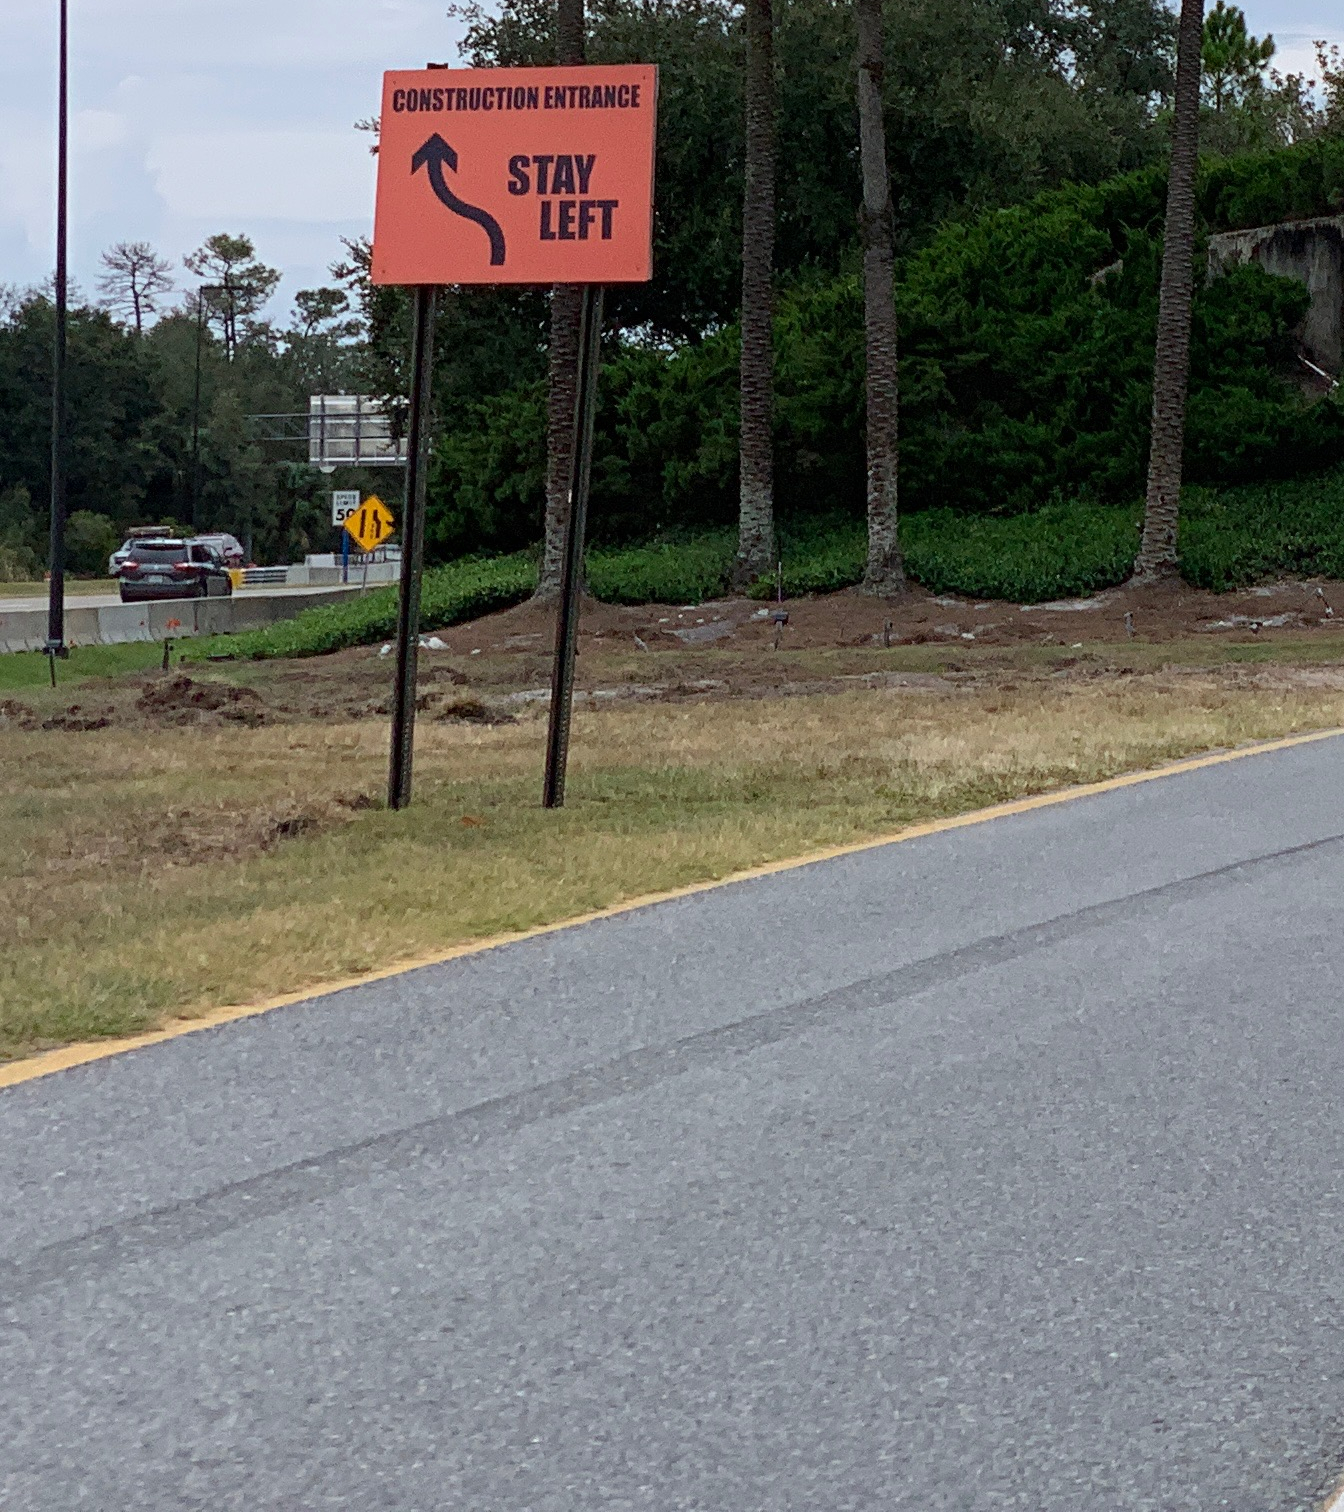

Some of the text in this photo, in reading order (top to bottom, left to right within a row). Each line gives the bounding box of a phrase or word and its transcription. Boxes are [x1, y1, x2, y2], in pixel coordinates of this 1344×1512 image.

[392, 84, 641, 113] CONSTRUCTION ENTRANCE
[507, 154, 597, 196] STAY
[539, 199, 619, 241] LEFT
